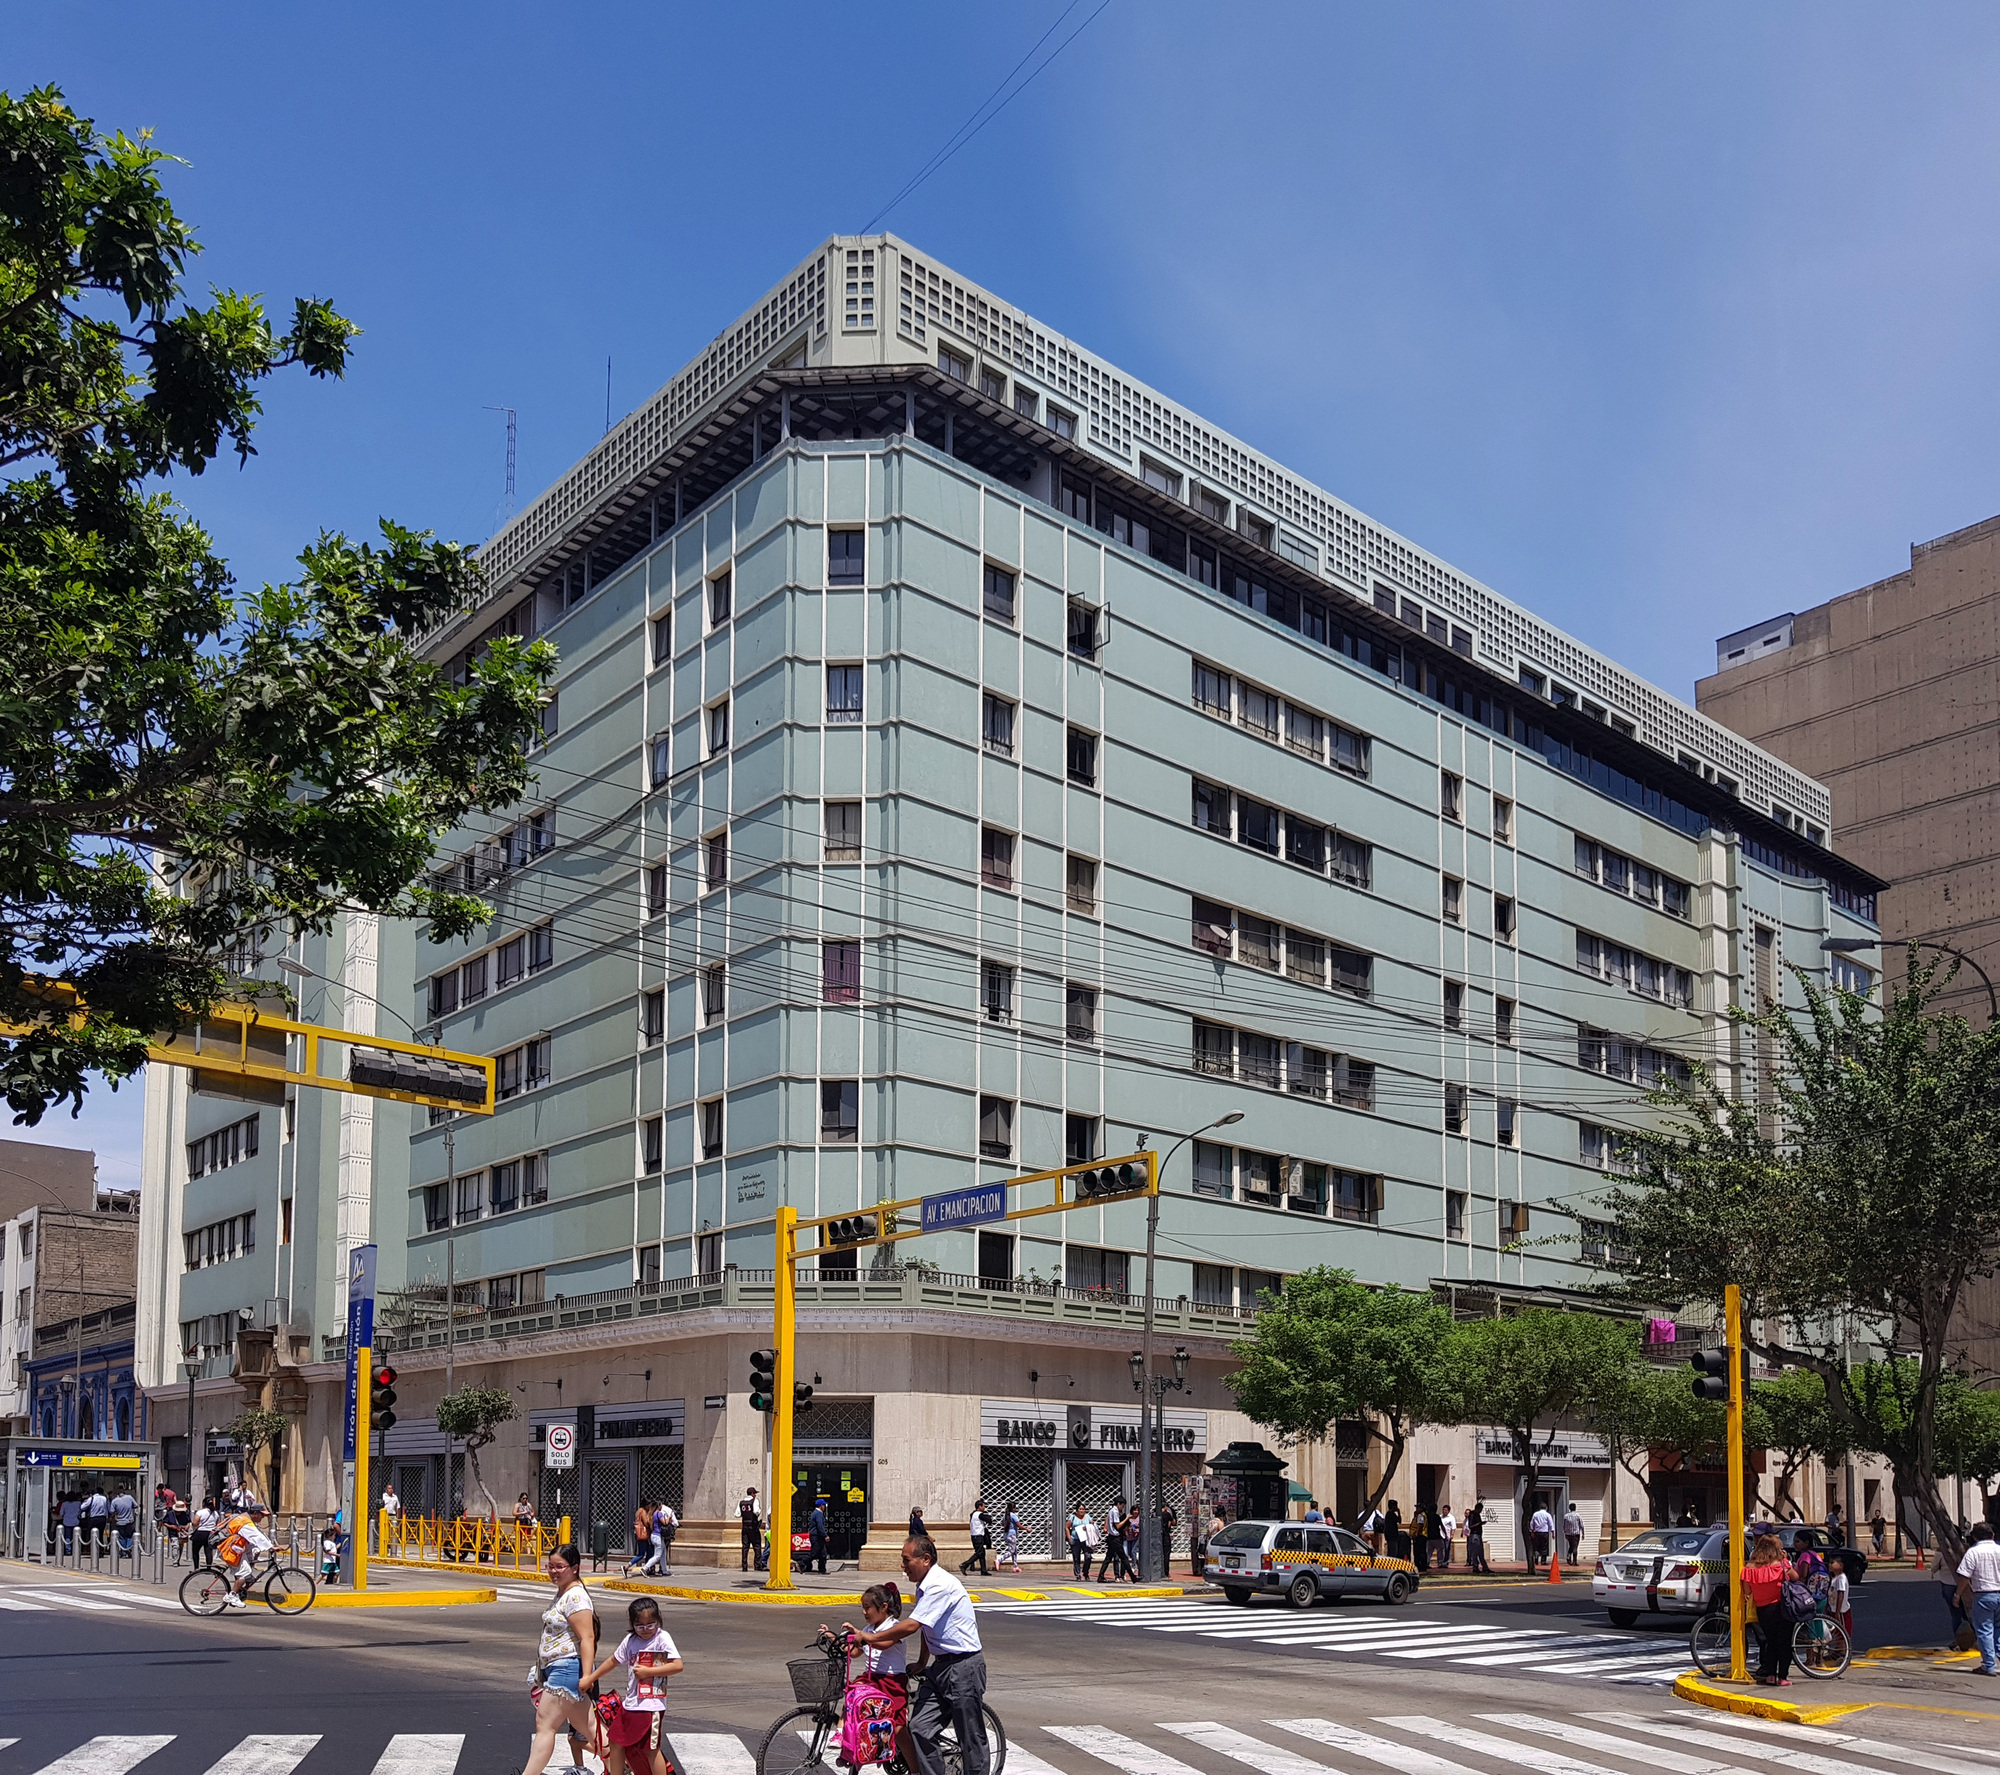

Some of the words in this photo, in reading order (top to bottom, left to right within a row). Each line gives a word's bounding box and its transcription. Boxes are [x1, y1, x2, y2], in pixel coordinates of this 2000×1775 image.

[926, 1204, 938, 1224] AV.
[940, 1192, 1001, 1221] EMANCIPACION
[352, 1360, 358, 1374] la
[350, 1379, 357, 1400] de
[997, 1419, 1057, 1441] BANCO
[1100, 1425, 1195, 1446] FINACERO
[1485, 1441, 1511, 1456] BANCO
